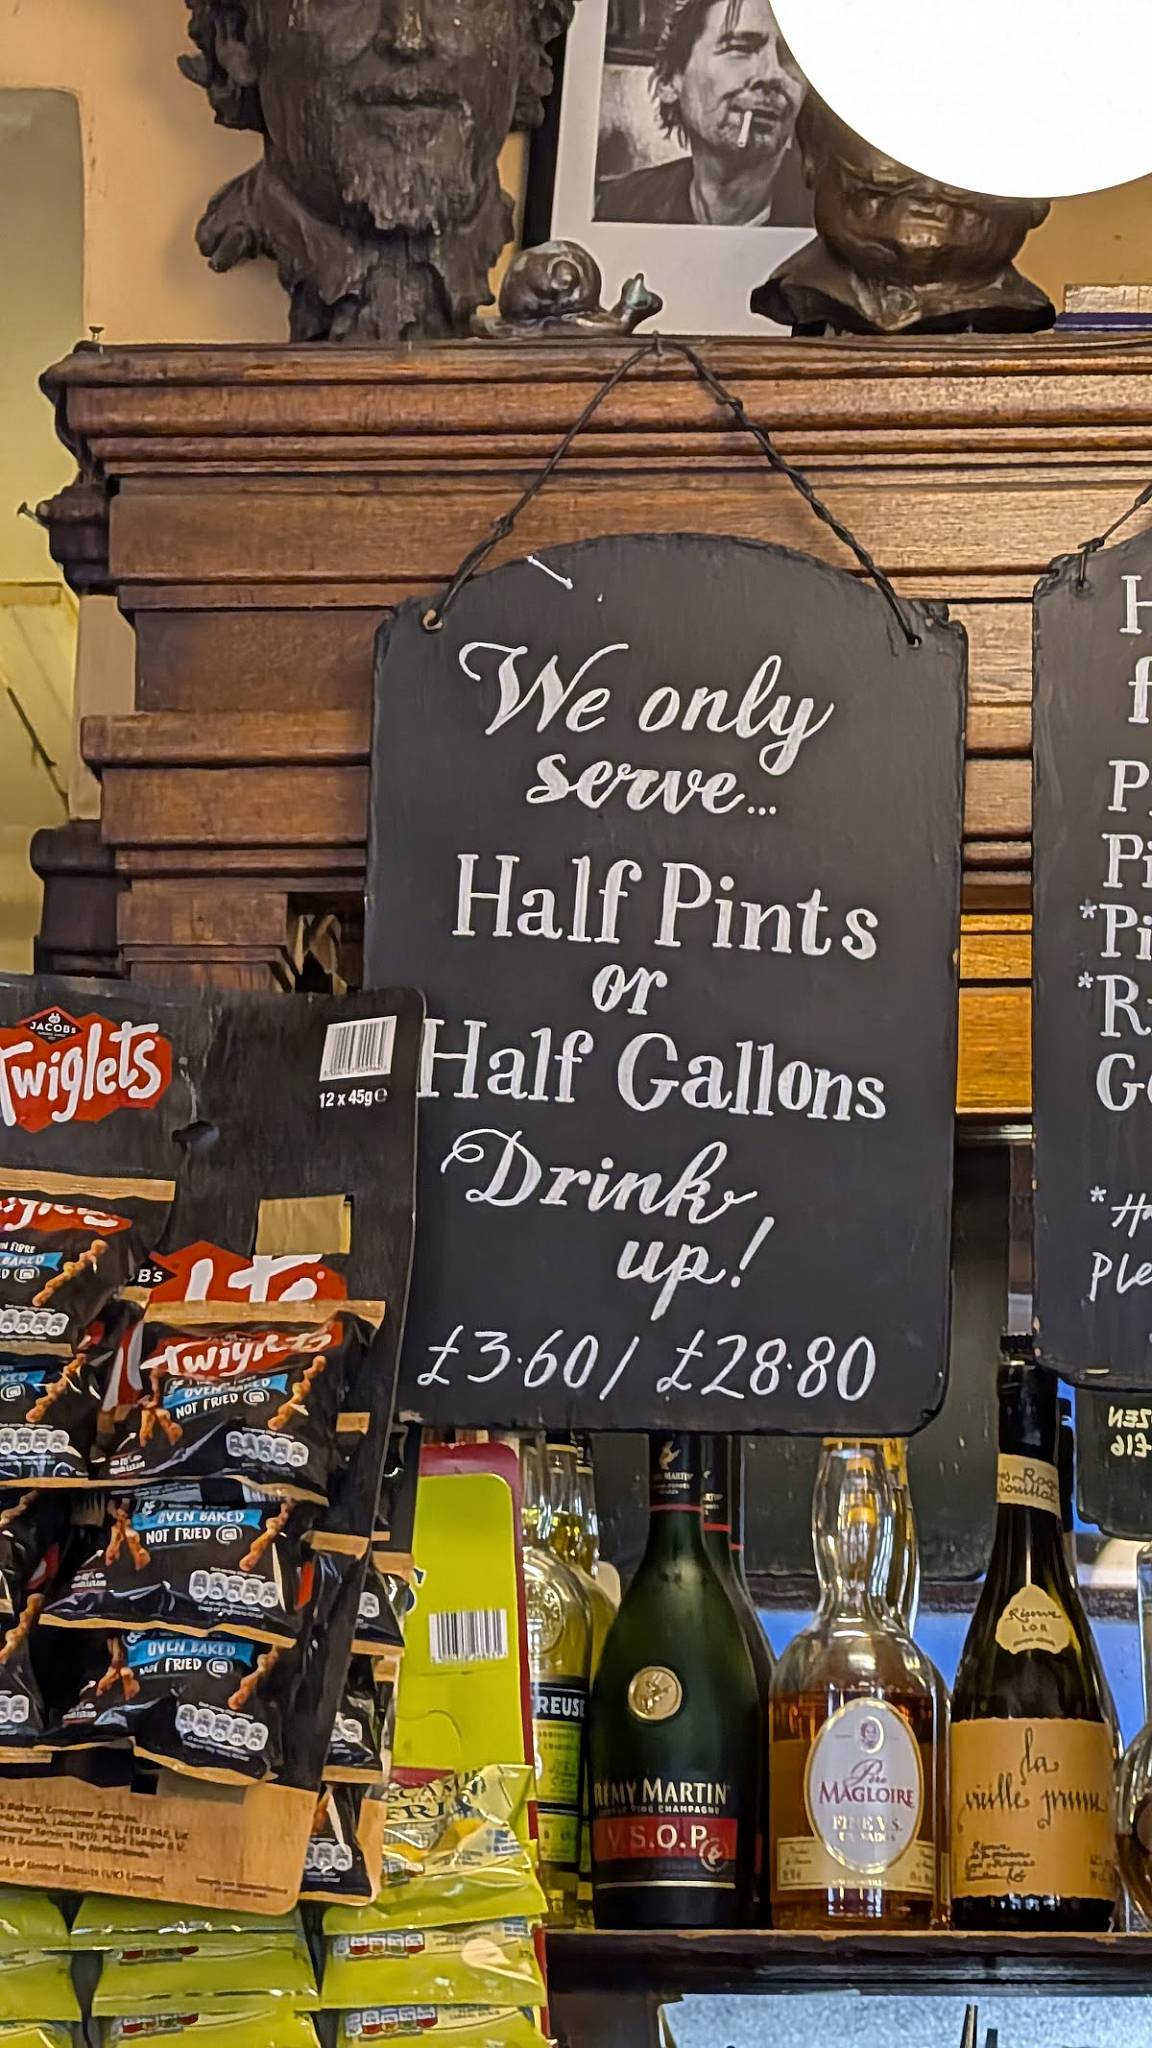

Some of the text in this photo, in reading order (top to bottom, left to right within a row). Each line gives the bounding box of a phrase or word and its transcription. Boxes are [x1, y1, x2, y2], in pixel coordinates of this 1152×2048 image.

[458, 641, 835, 776] We only
[451, 853, 879, 960] Half Pints
[592, 964, 668, 1016] or
[0, 1021, 162, 1127] Twiglets
[417, 1018, 886, 1121] Half Gallons
[319, 1091, 335, 1109] 12
[337, 1094, 346, 1106] x
[440, 1128, 758, 1225] Drink
[616, 1216, 775, 1321] up!
[184, 1384, 224, 1398] OVEN
[175, 1392, 240, 1420] NOT FRIED
[199, 1509, 245, 1523] BAKED
[145, 1526, 211, 1545] NOT FRIED
[190, 1641, 236, 1657] BAKED
[165, 1657, 202, 1673] FRIED
[1019, 1727, 1060, 1786] la
[642, 1776, 728, 1806] MARTIN
[819, 1780, 915, 1809] MAGLOIRE
[658, 1804, 721, 1816] CHAMPAGNE
